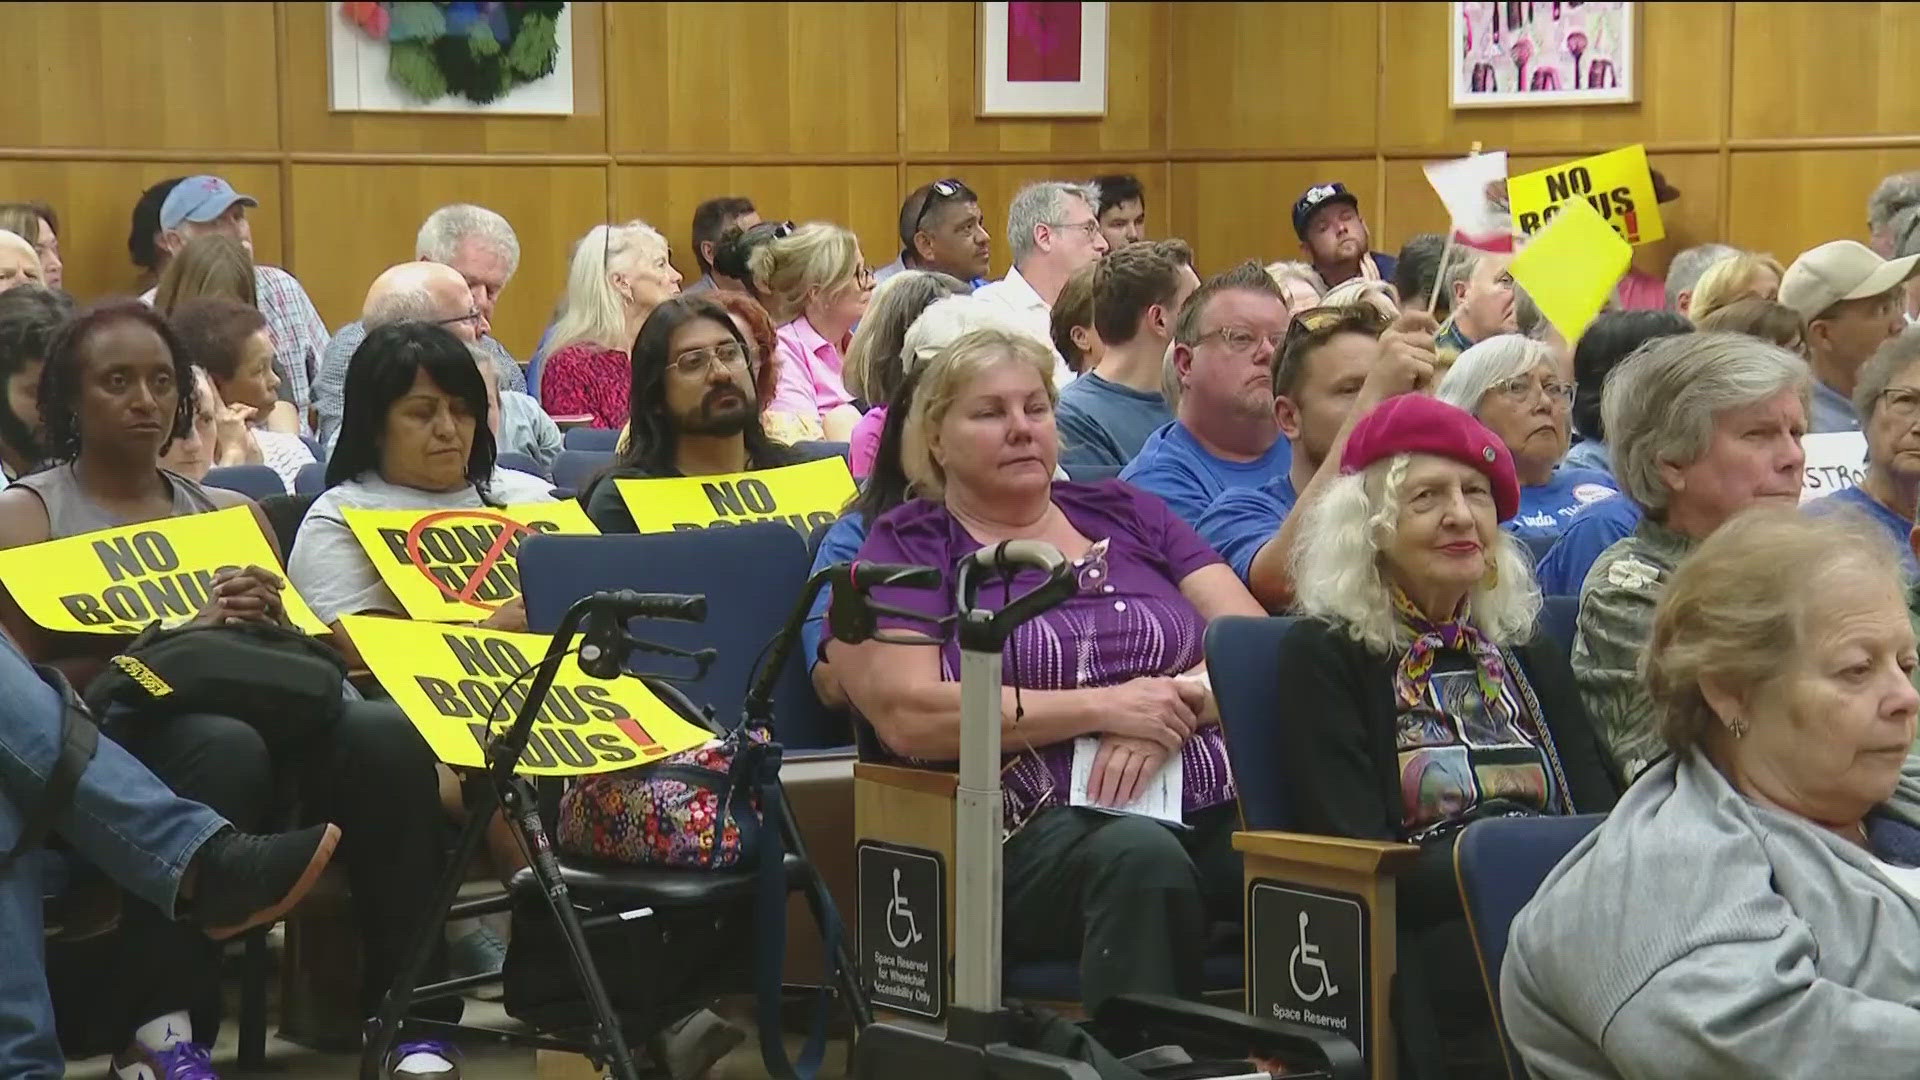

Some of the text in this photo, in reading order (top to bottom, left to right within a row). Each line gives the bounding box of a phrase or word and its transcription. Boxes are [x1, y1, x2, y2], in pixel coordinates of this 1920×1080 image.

[1545, 166, 1593, 203] NO
[700, 479, 777, 518] NO
[91, 531, 180, 582] NO
[59, 565, 243, 626] BONU
[441, 633, 536, 680] NO
[874, 950, 929, 973] Space Reserved
[878, 966, 926, 988] for Wheelchair
[915, 989, 930, 1006] Only
[1272, 1003, 1348, 1030] Space Reserved
